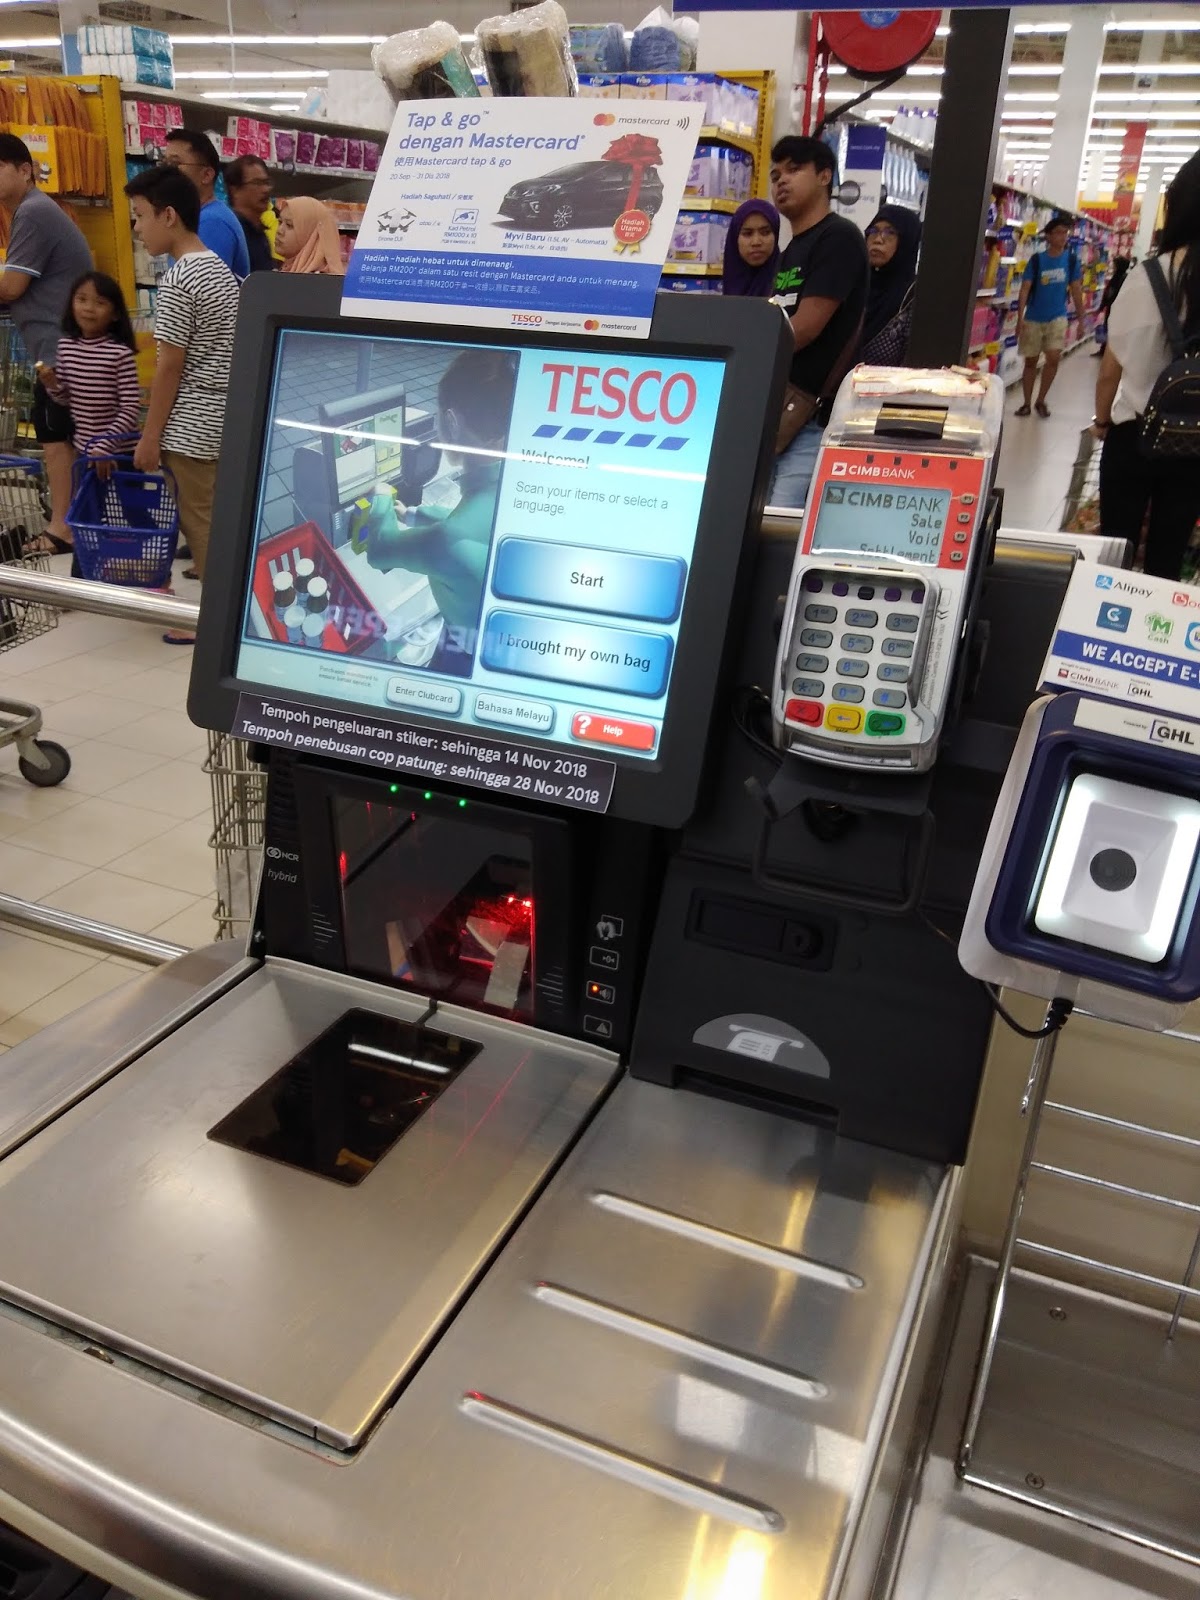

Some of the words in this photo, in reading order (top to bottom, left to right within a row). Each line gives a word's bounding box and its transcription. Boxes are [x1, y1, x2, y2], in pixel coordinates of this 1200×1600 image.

[407, 113, 436, 130] Tap
[441, 112, 453, 126] &
[618, 117, 670, 125] mastercard
[400, 135, 463, 152] dengan
[415, 157, 468, 166] Mastercard
[470, 157, 486, 167] tap
[489, 157, 496, 166] &
[499, 158, 512, 167] go
[424, 193, 451, 201] Saguhati
[620, 224, 643, 232] Utama
[621, 218, 645, 226] Hadiah
[504, 232, 524, 241] Myvi
[526, 232, 546, 242] Baru
[363, 254, 389, 262] Hadiah
[422, 257, 445, 265] hebat
[446, 257, 469, 266] untuk
[471, 258, 515, 270] dimenangi.
[361, 264, 387, 274] Belanja
[418, 268, 441, 276] dalam
[443, 269, 459, 277] satu
[461, 270, 478, 278] resit
[480, 270, 508, 280] dengan
[511, 271, 556, 282] Mastercard
[557, 275, 577, 283] anda
[579, 276, 602, 285] untuk
[605, 278, 640, 289] menang.
[512, 313, 543, 323] TESCO
[601, 323, 637, 331] mastercard
[542, 363, 697, 425] TESCO
[848, 464, 880, 477] CIMB
[882, 467, 916, 480] BANK
[515, 480, 544, 495] Scan
[547, 487, 572, 499] your
[574, 487, 605, 503] items
[608, 494, 621, 504] or
[623, 495, 658, 508] select
[660, 500, 669, 510] a
[847, 491, 893, 509] CIMB
[895, 495, 945, 513] BANK
[911, 513, 942, 529] Sale
[909, 530, 940, 547] Void
[570, 571, 604, 588] Start
[1114, 581, 1154, 599] Alipay
[852, 613, 859, 622] 2
[892, 617, 900, 627] 3
[808, 633, 815, 643] 4
[848, 638, 855, 648] 5
[1148, 635, 1169, 645] Cash
[499, 632, 504, 645] I
[506, 633, 561, 658] brought
[564, 646, 586, 661] my
[590, 648, 619, 665] own
[624, 649, 651, 673] bag
[888, 642, 895, 652] 6
[804, 657, 812, 667] 7
[843, 662, 851, 672] 8
[1082, 642, 1108, 660] WE
[1109, 649, 1178, 677] ACCEPT
[1180, 665, 1200, 681] E-
[884, 667, 891, 677] 9
[1070, 672, 1094, 683] CIMB
[1095, 677, 1119, 688] BANK
[394, 685, 415, 697] Enter
[417, 688, 453, 704] Clubcard
[1132, 687, 1154, 698] GHL
[477, 700, 513, 716] Bahasa
[516, 707, 550, 724] Melayu
[603, 723, 624, 738] Help
[1157, 726, 1195, 745] GHL
[260, 702, 310, 724] Tempoh
[313, 715, 393, 740] pengeluaran
[396, 731, 438, 748] stiker:
[441, 740, 501, 763] sehingga
[505, 750, 519, 765] 14
[522, 753, 551, 771] Nov
[553, 759, 588, 778] 2018
[242, 720, 293, 742] Tempoh
[294, 734, 366, 758] penebusan
[369, 749, 394, 765] cop
[396, 754, 448, 776] patung:
[450, 764, 511, 788] sehingga
[513, 775, 531, 791] 28
[534, 779, 563, 797] Nov
[565, 785, 600, 804] 2018
[282, 851, 299, 862] NCR
[267, 868, 298, 883] hybrid
